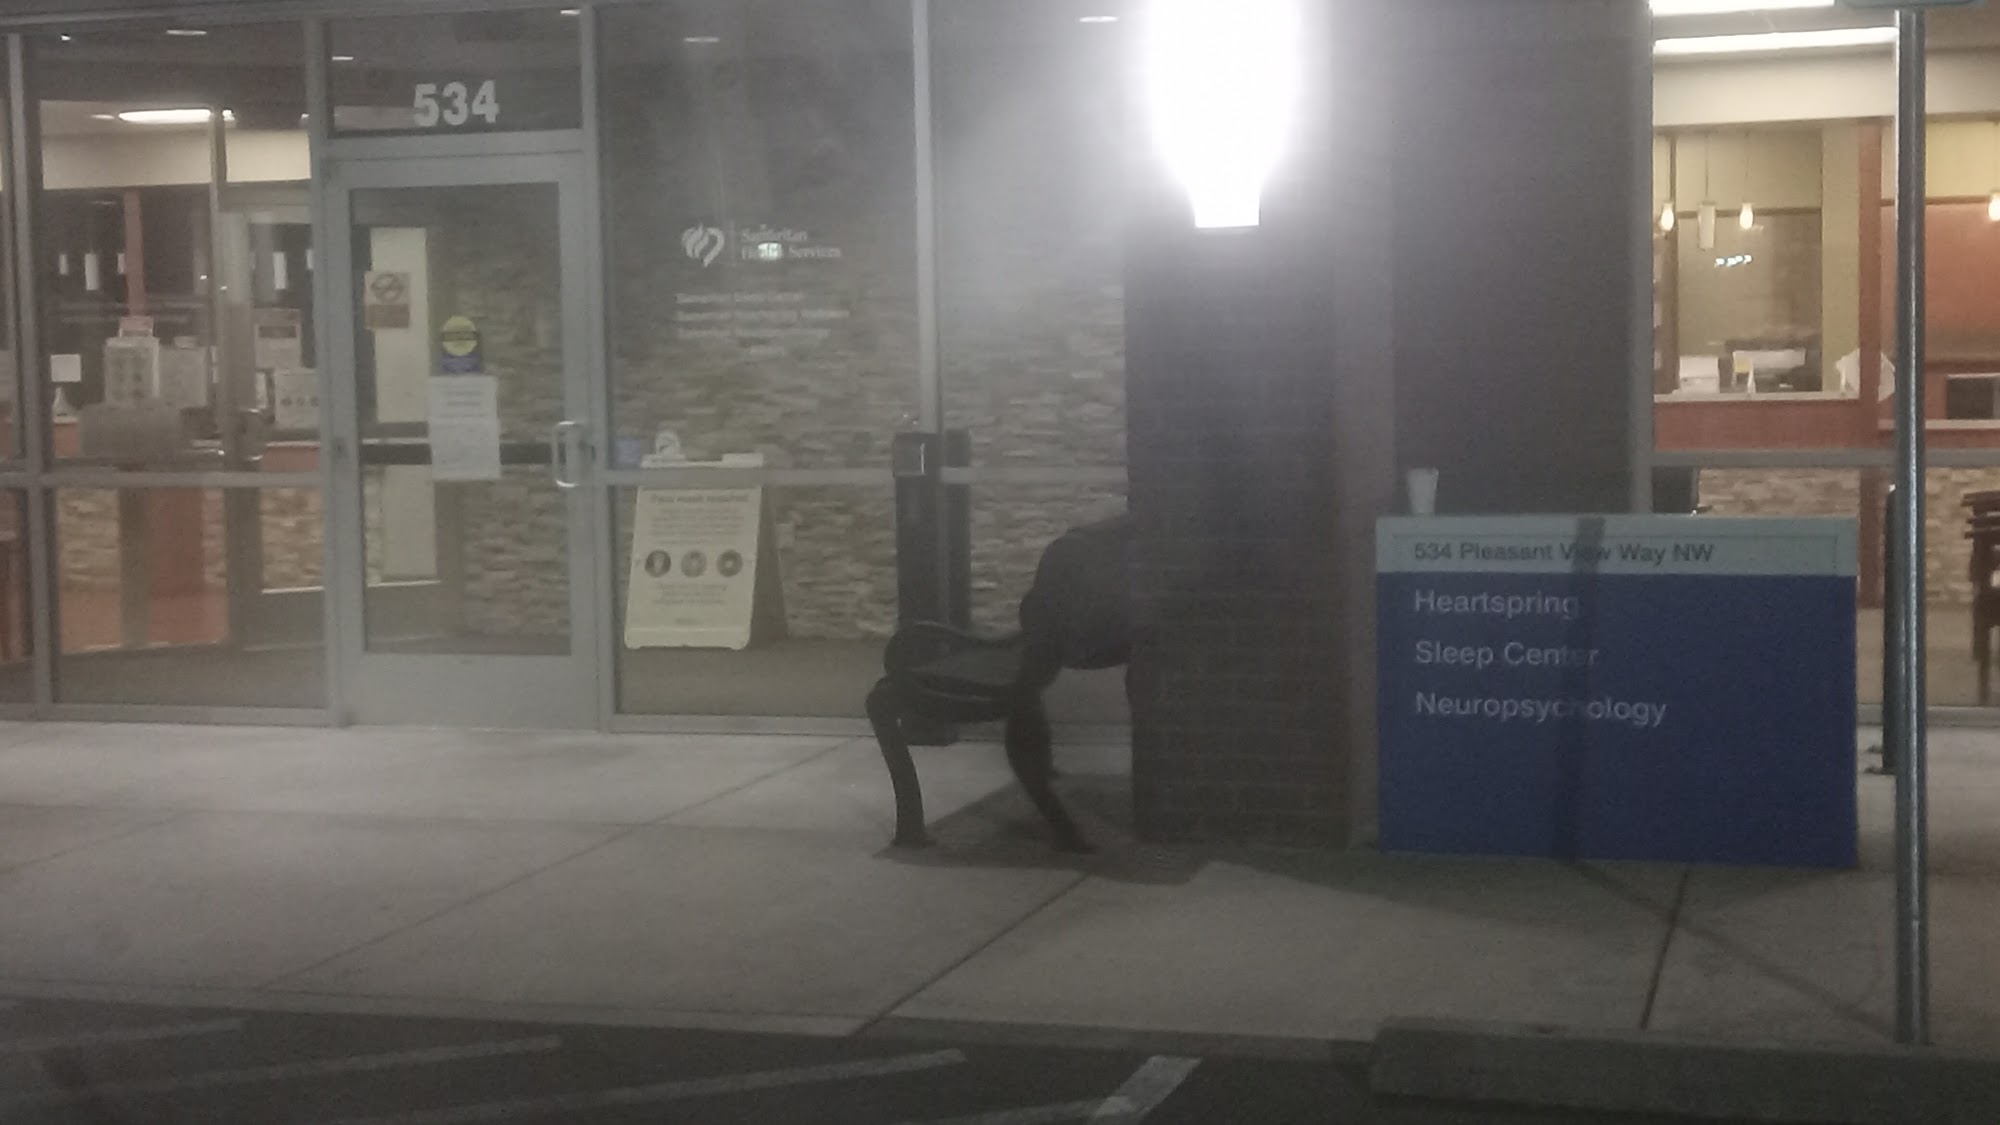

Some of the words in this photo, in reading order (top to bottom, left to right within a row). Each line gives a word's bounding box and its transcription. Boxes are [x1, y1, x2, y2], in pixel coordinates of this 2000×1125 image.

[413, 80, 500, 127] 534
[1413, 541, 1453, 560] 534
[1459, 541, 1553, 561] Pleasant
[1619, 543, 1667, 566] Way
[1672, 543, 1716, 562] NW
[1414, 588, 1579, 621] Heartspring
[1414, 639, 1494, 670] Sleep
[1415, 690, 1668, 728] Neuropsycology
